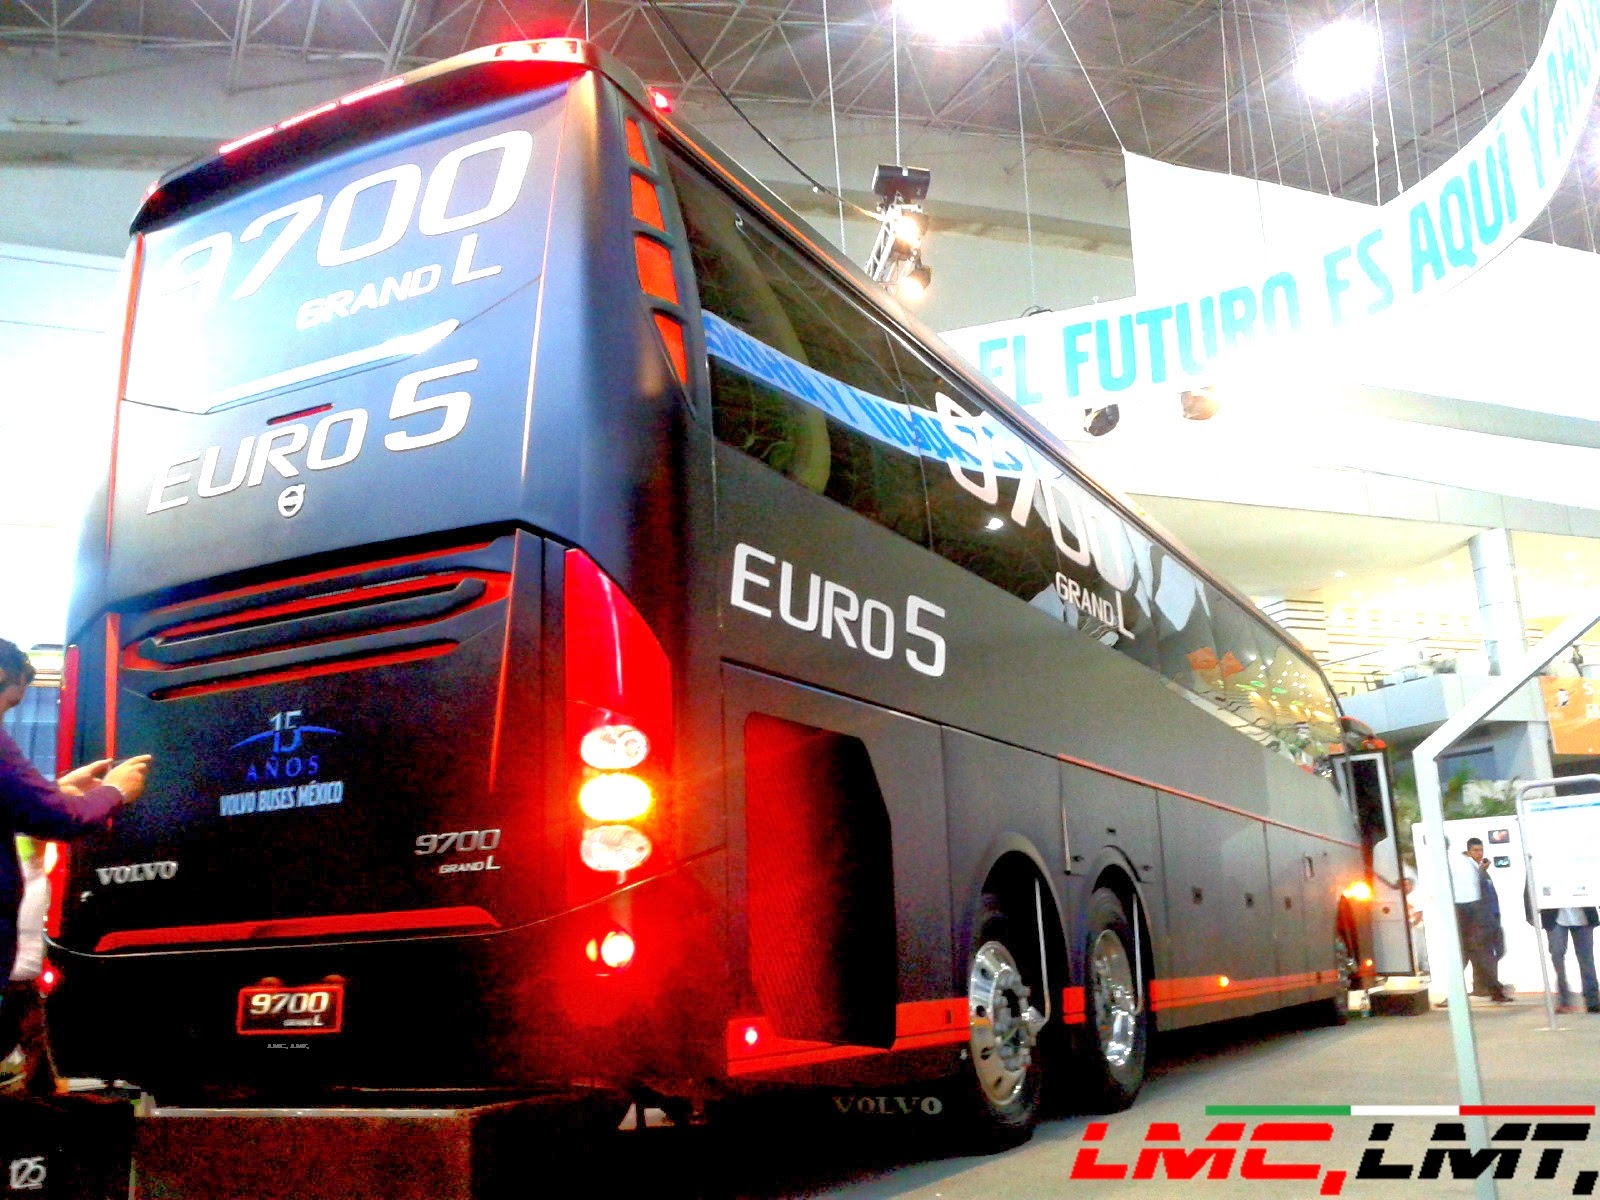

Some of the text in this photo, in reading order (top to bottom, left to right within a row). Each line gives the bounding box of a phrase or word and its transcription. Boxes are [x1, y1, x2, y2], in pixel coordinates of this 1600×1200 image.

[158, 130, 534, 306] 9700
[979, 334, 1043, 406] EL
[1520, 85, 1545, 190] Y
[295, 233, 502, 330] GRAND L
[146, 358, 479, 515] EURO 5
[730, 542, 947, 678] EURO 5
[1055, 571, 1136, 641] GRAND L
[268, 710, 303, 754] 15
[245, 755, 320, 782] AÑOS
[257, 785, 297, 813] BUSES
[414, 828, 502, 856] 9700
[95, 860, 179, 886] VOLVO
[439, 855, 502, 875] GRAND L
[250, 991, 330, 1015] 9700
[832, 1095, 943, 1116] VOLVO
